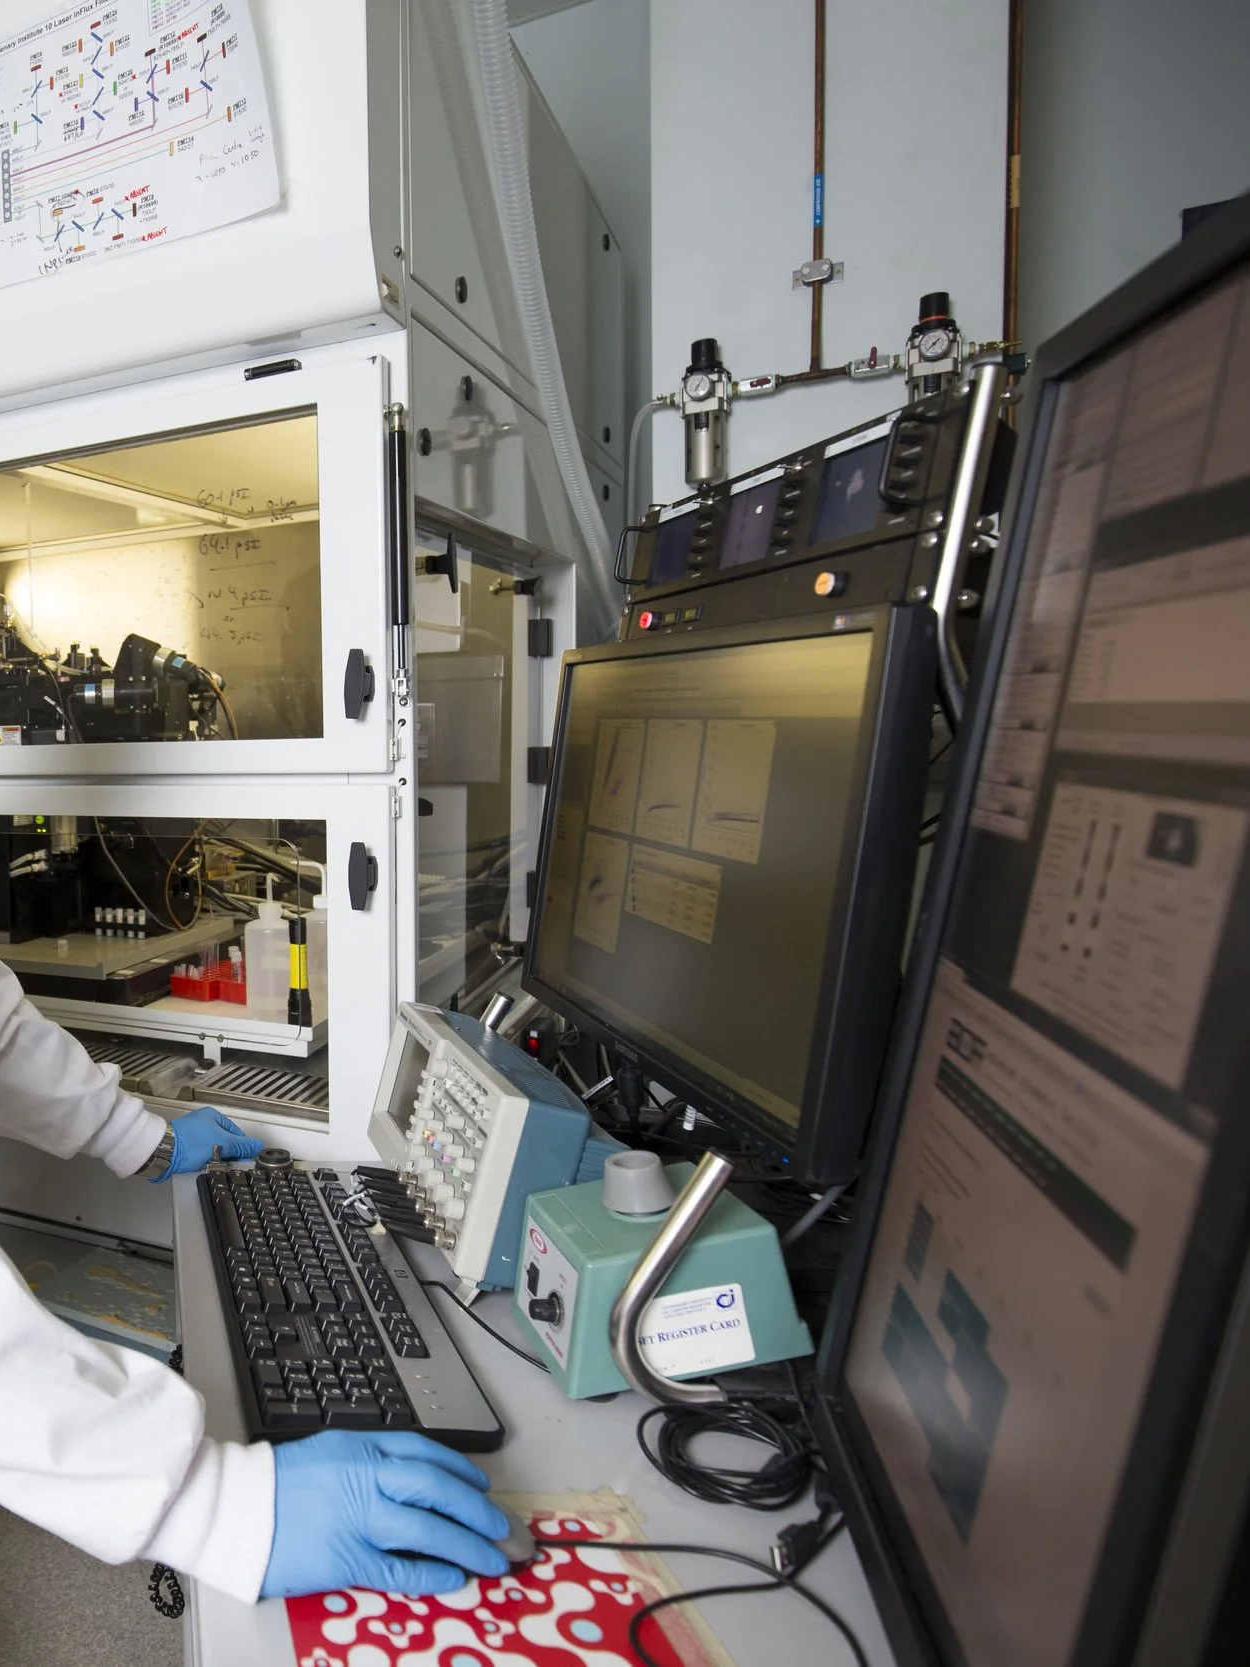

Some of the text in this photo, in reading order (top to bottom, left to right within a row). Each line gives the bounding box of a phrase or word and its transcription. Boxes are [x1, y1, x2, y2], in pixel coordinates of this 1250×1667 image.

[17, 27, 44, 44] Institute
[45, 22, 53, 31] 10
[53, 14, 73, 28] Laser
[73, 4, 94, 19] inFlux
[223, 140, 244, 155] Centre
[130, 185, 150, 199] ABSENT
[147, 227, 168, 240] ABSENT
[199, 533, 230, 555] 64.1
[657, 1324, 708, 1343] REGISTER
[709, 1318, 742, 1333] CARD
